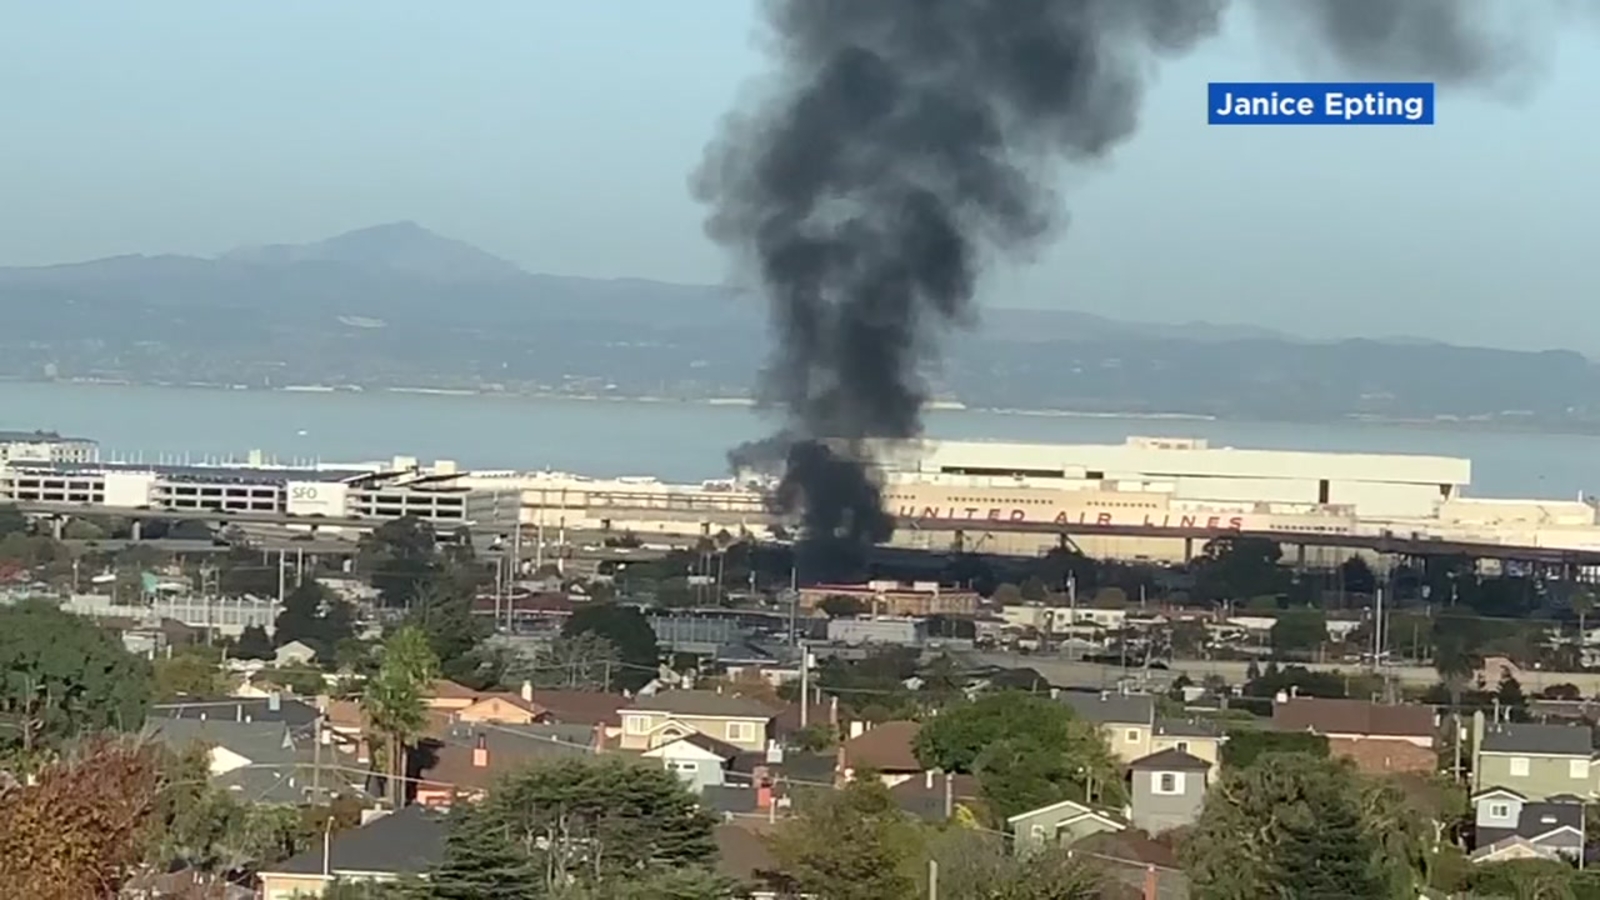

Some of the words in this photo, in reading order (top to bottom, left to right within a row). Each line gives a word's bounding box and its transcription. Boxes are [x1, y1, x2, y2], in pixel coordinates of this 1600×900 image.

[292, 487, 318, 499] SFO
[899, 505, 1025, 521] UNITED
[1054, 510, 1112, 526] AIR
[1143, 513, 1243, 531] LINES
